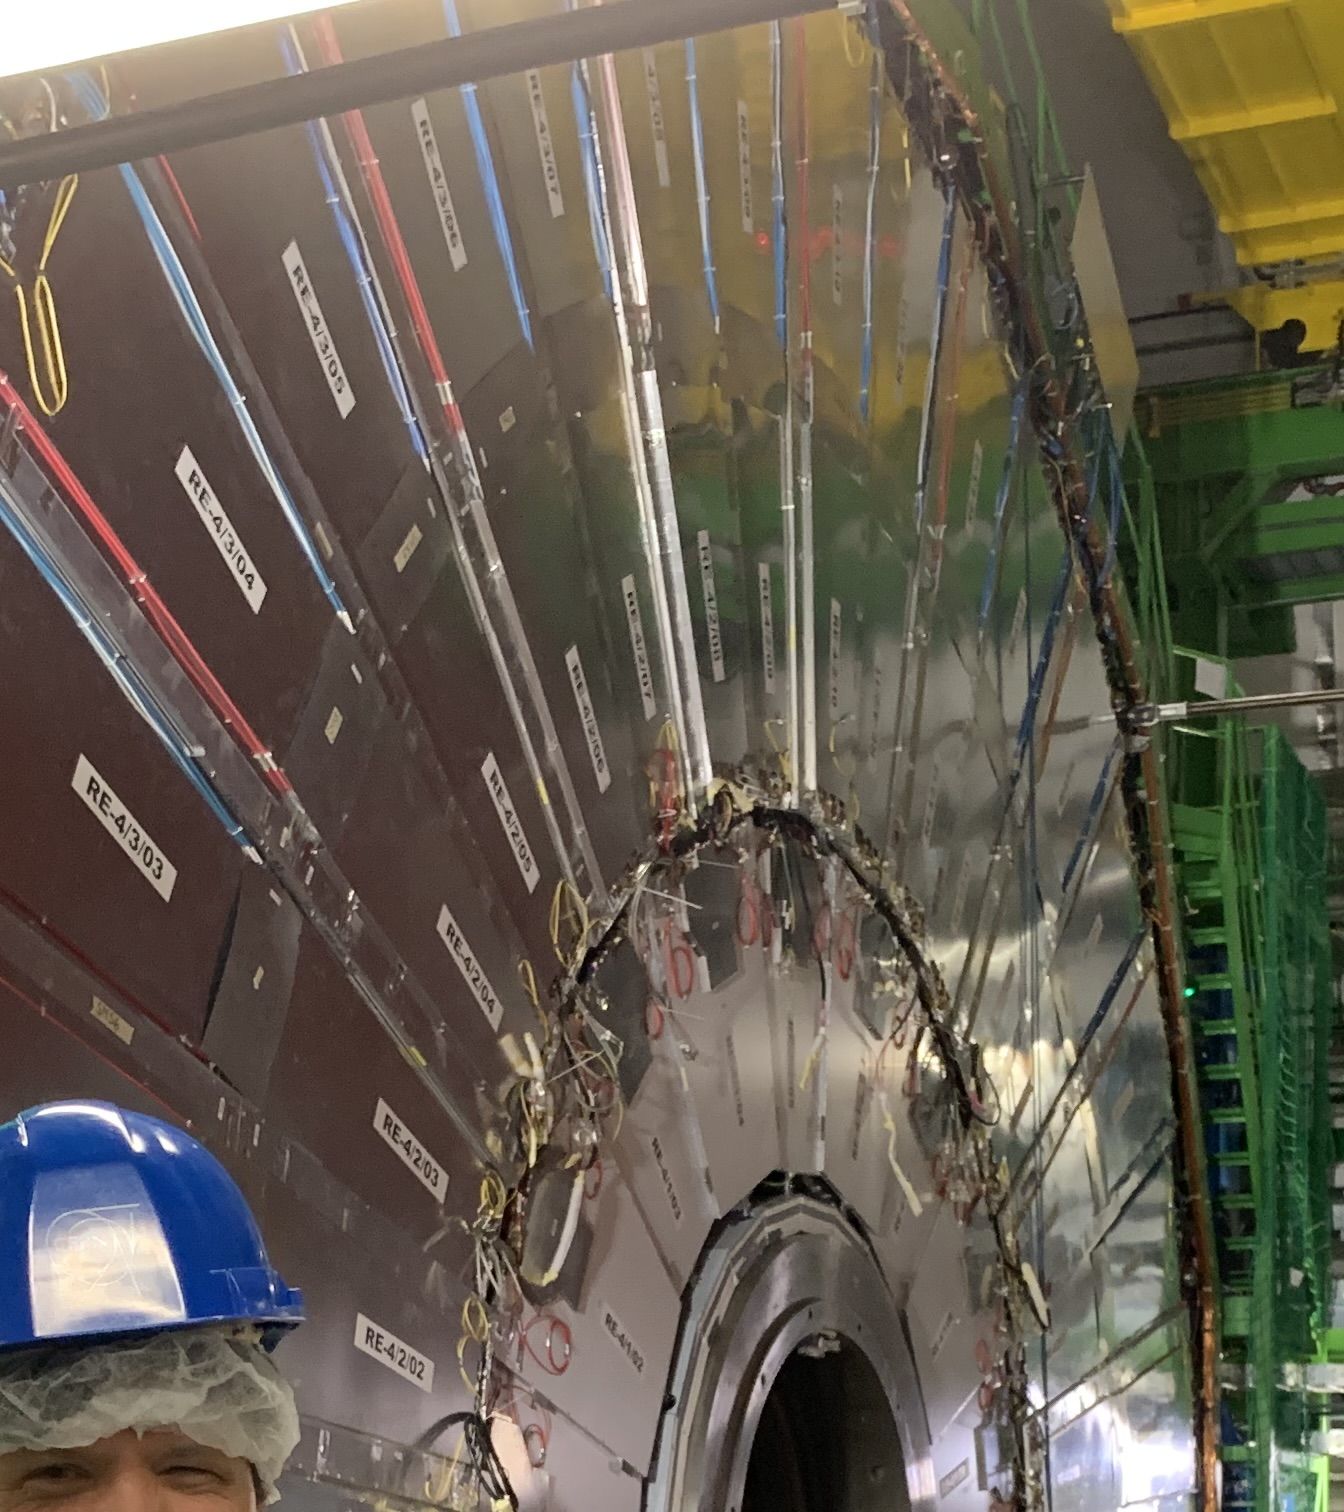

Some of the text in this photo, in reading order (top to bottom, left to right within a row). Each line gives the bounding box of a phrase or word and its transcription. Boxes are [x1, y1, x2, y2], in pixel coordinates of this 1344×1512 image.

[419, 119, 460, 250] RE-4/3/06
[292, 264, 343, 395] RE-4/3/05
[187, 468, 256, 592] RE-4/3/04
[571, 663, 605, 774] RE-4/2/06
[85, 774, 164, 881] RE-4/3/03
[489, 768, 532, 873] RE-4/2/05
[446, 922, 496, 1014] RE-4/2/04
[382, 1112, 439, 1188] RE-4/2/03
[365, 1326, 425, 1381] RE-4/2/02
[604, 1312, 645, 1374] RE-4/1/02
